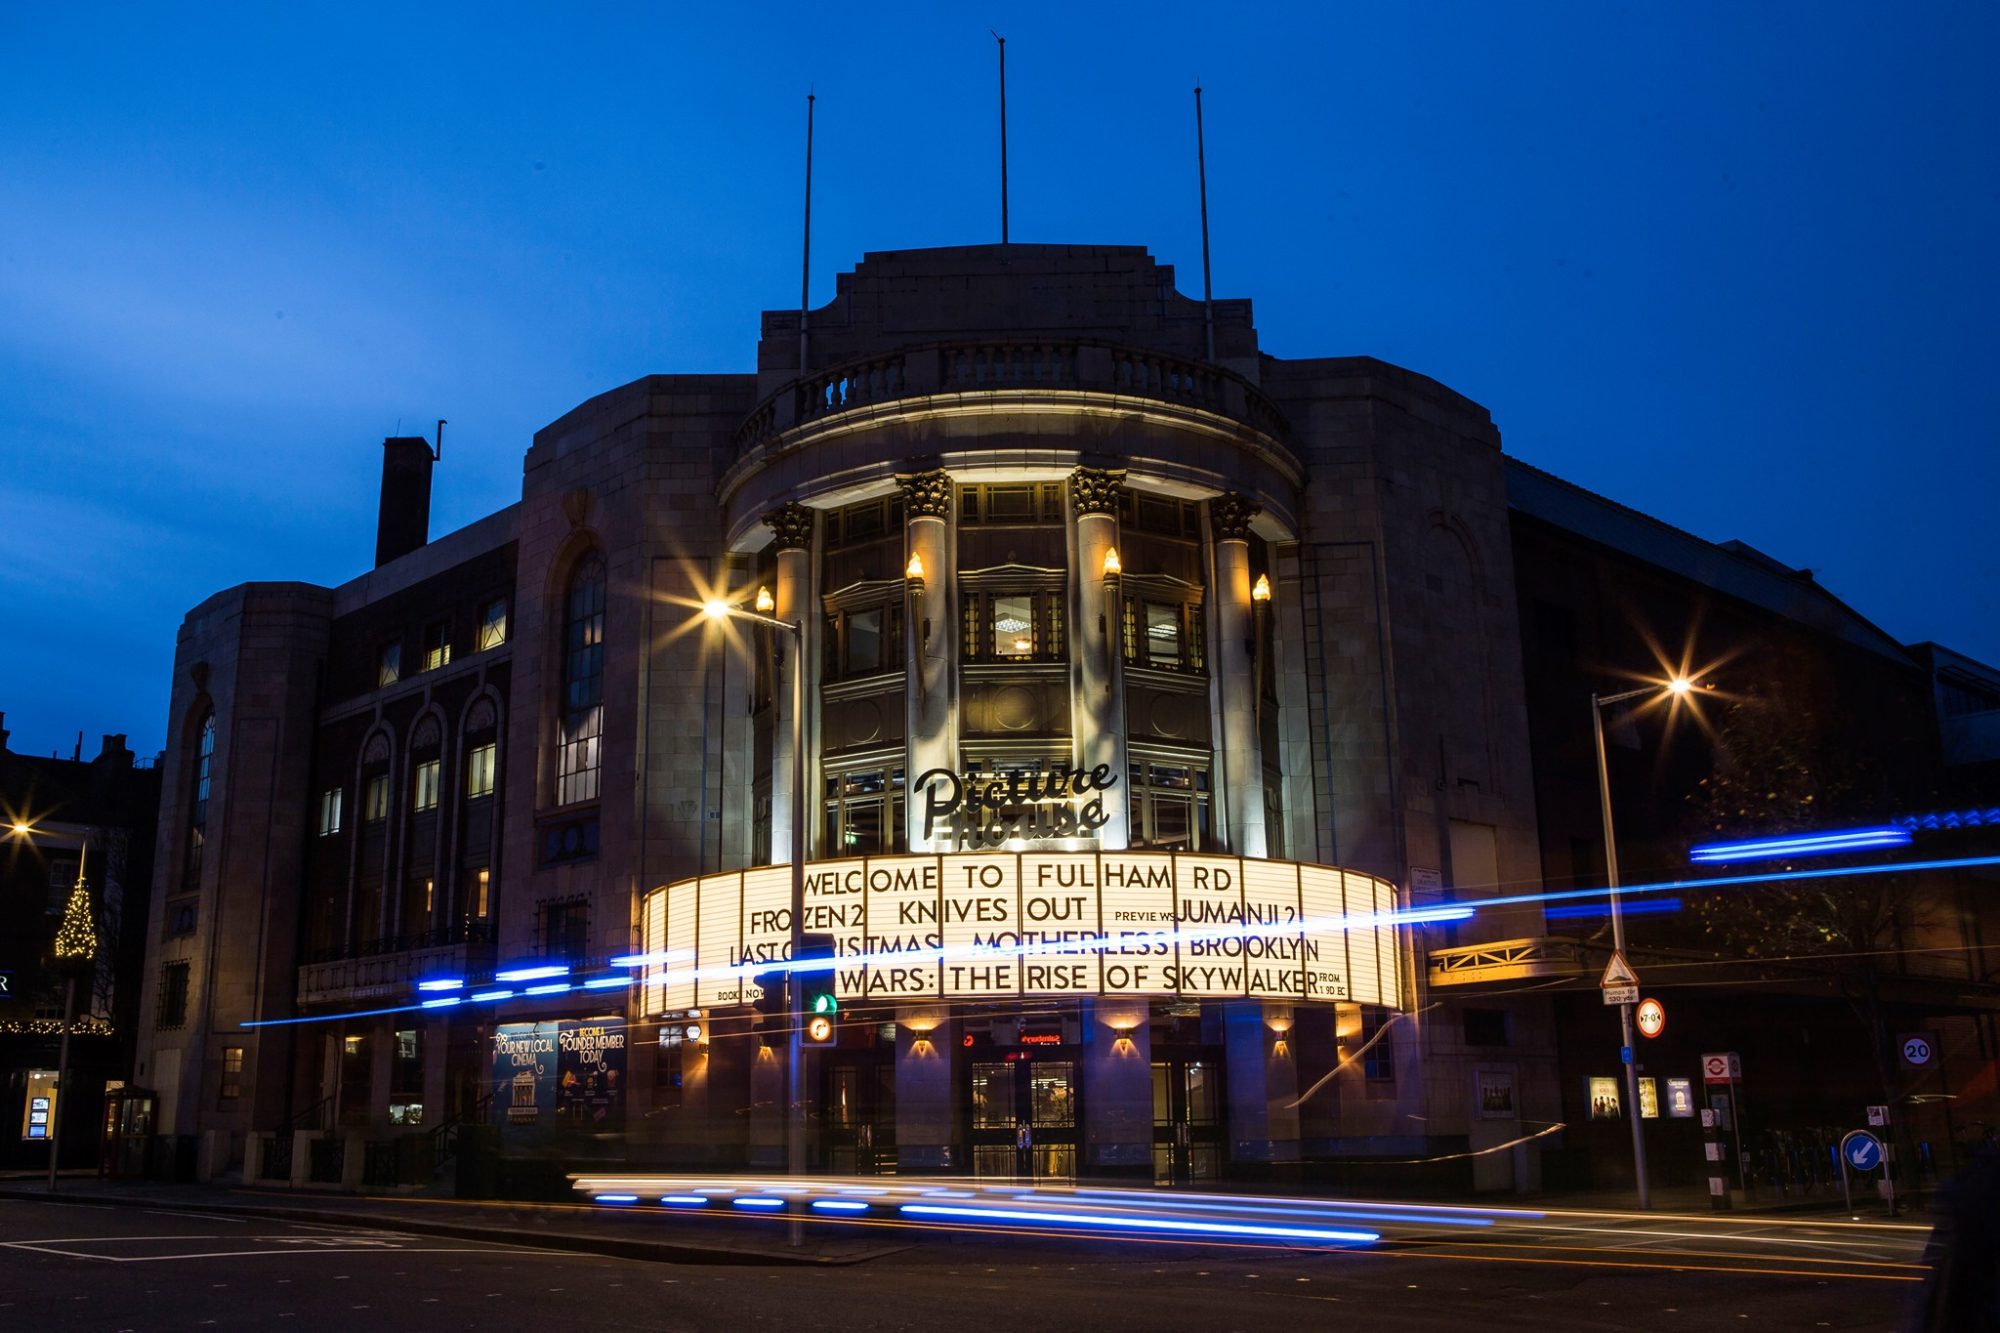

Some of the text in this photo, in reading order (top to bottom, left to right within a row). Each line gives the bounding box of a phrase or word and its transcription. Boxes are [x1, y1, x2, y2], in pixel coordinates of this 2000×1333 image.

[913, 763, 1118, 840] Picture
[805, 863, 1231, 896] WELCOME TO FULHAM RD
[899, 898, 1007, 925] KNIVES
[1027, 897, 1087, 922] OUT
[1176, 899, 1278, 926] JUMANJI
[730, 941, 780, 967] LAST
[1189, 932, 1319, 962] BROOKLYN
[949, 965, 1012, 990] THE
[1027, 965, 1088, 989] RISE
[1106, 965, 1149, 989] OF
[1162, 965, 1318, 994] SKYWALKER
[1319, 972, 1341, 983] FROM
[515, 1040, 531, 1054] NEW
[531, 1038, 554, 1053] LOCAL
[559, 1029, 595, 1053] FOUNDER
[595, 1034, 625, 1051] MEMBER
[1906, 1044, 1928, 1058] 20
[579, 1049, 607, 1073] TODAY
